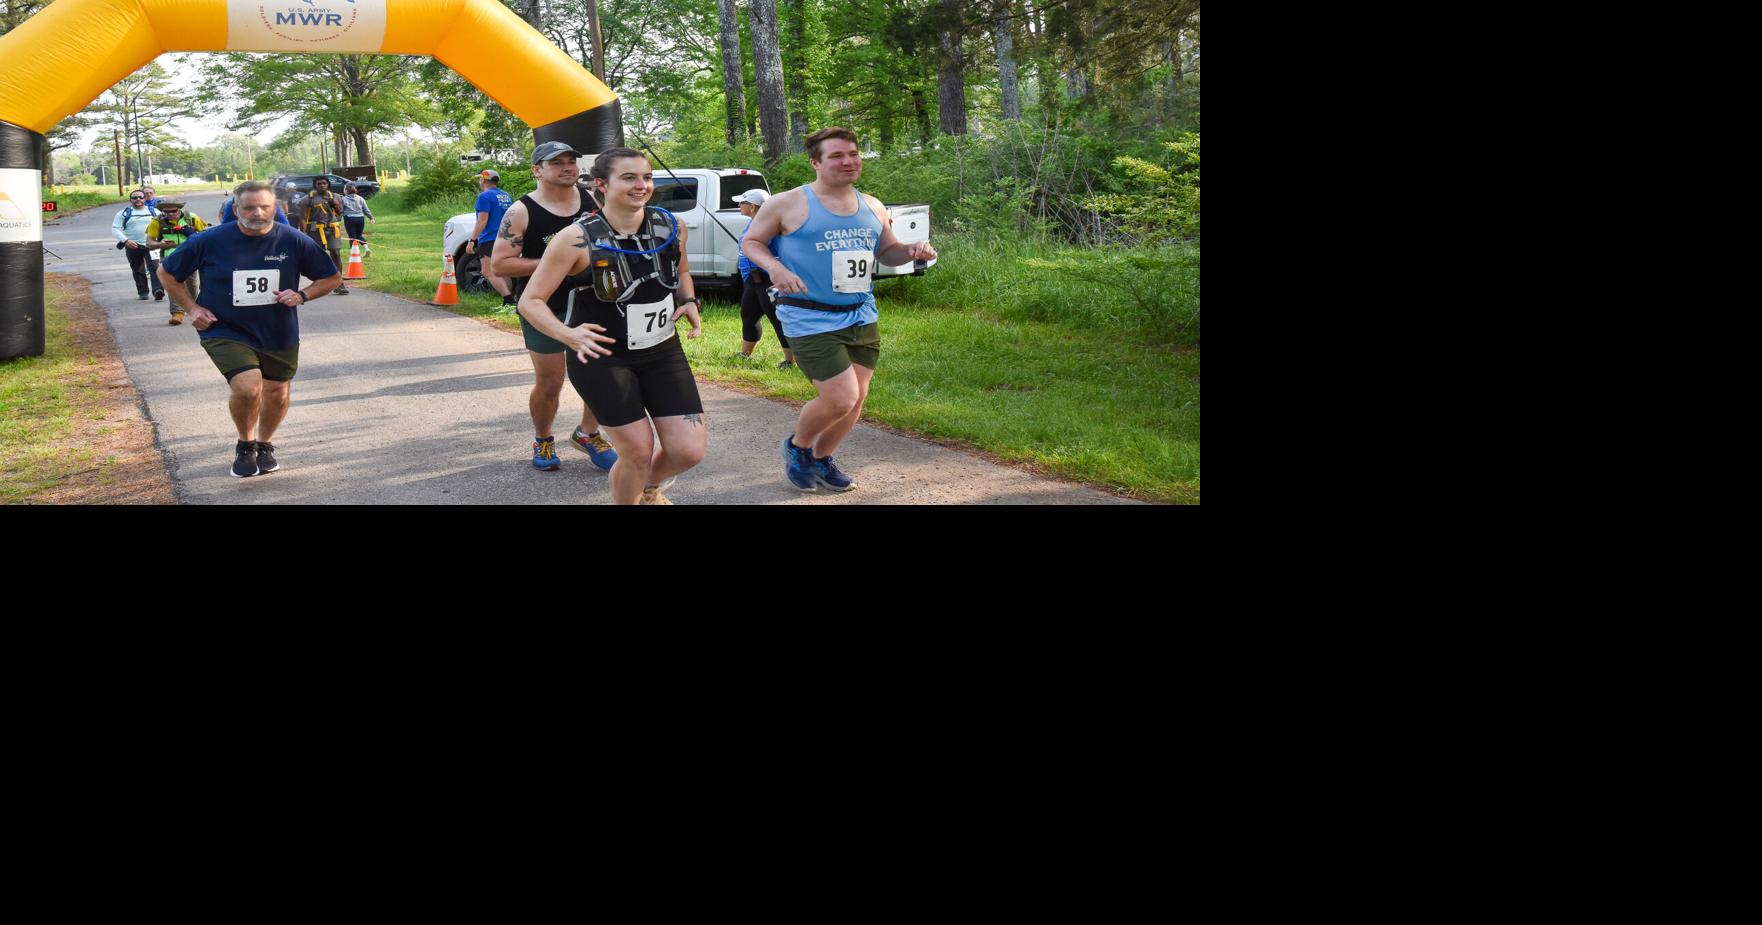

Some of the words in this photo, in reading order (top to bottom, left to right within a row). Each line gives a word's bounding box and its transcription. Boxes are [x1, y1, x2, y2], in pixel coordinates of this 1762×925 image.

[276, 12, 342, 26] MWR
[824, 228, 873, 240] CHANGE
[847, 259, 867, 278] 39
[246, 277, 268, 293] 58
[644, 307, 667, 333] 76
